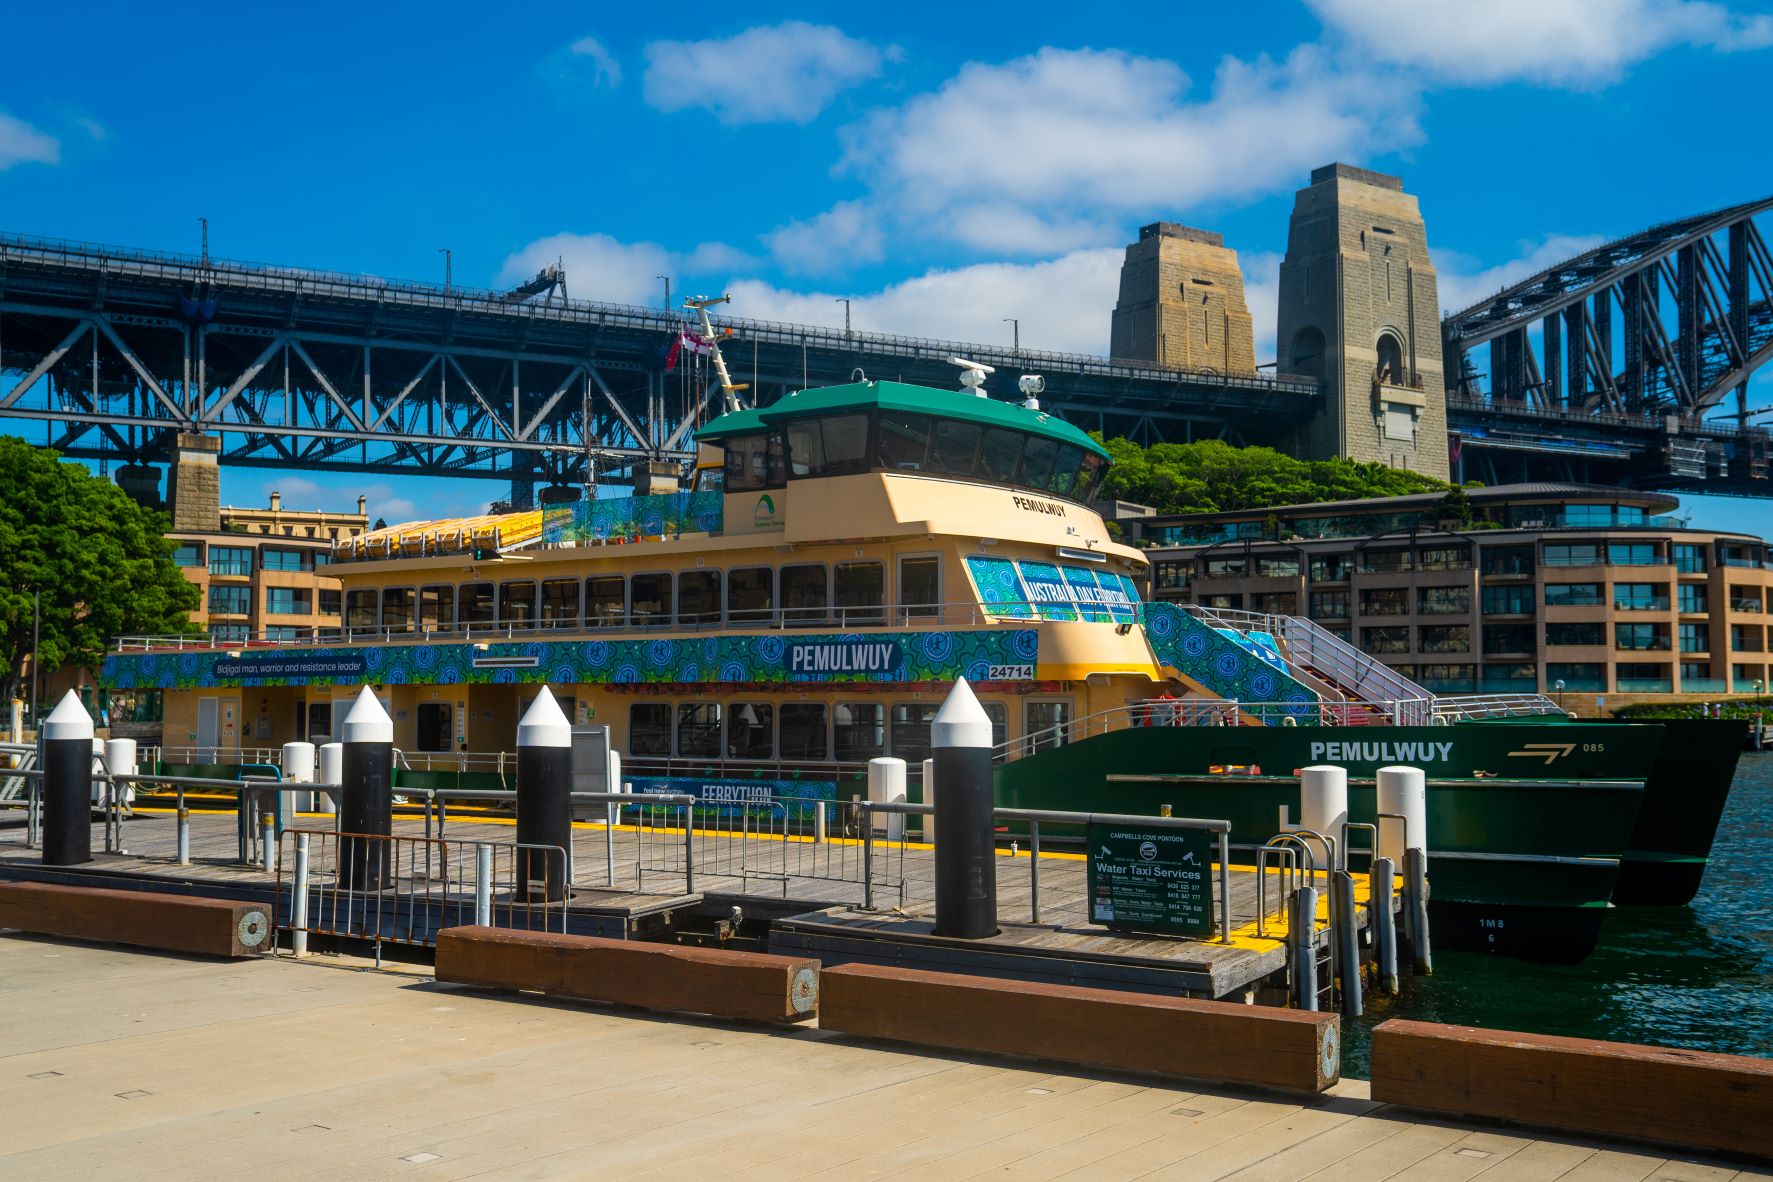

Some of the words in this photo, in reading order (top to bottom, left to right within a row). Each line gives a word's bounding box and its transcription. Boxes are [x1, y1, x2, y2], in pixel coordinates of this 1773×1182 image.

[1013, 496, 1066, 517] PEMULWUY
[1025, 581, 1080, 605] AUSTRALA
[1075, 585, 1096, 605] DAY
[792, 644, 893, 671] PEMULWUY
[217, 664, 240, 676] Bidjigal
[242, 665, 258, 674] man,
[260, 664, 283, 673] warrior
[285, 663, 298, 672] and
[300, 663, 336, 671] resistance
[338, 662, 361, 671] leader
[990, 667, 1032, 677] 24714
[1310, 742, 1453, 761] PEMULWUY
[1583, 744, 1604, 752] 085
[702, 785, 772, 806] FERRYTHON
[1110, 832, 1141, 840] CAMPBELLS
[1096, 862, 1127, 874] Water
[1130, 865, 1152, 876] Taxi
[1154, 867, 1201, 880] Services
[1488, 934, 1495, 942] 6
